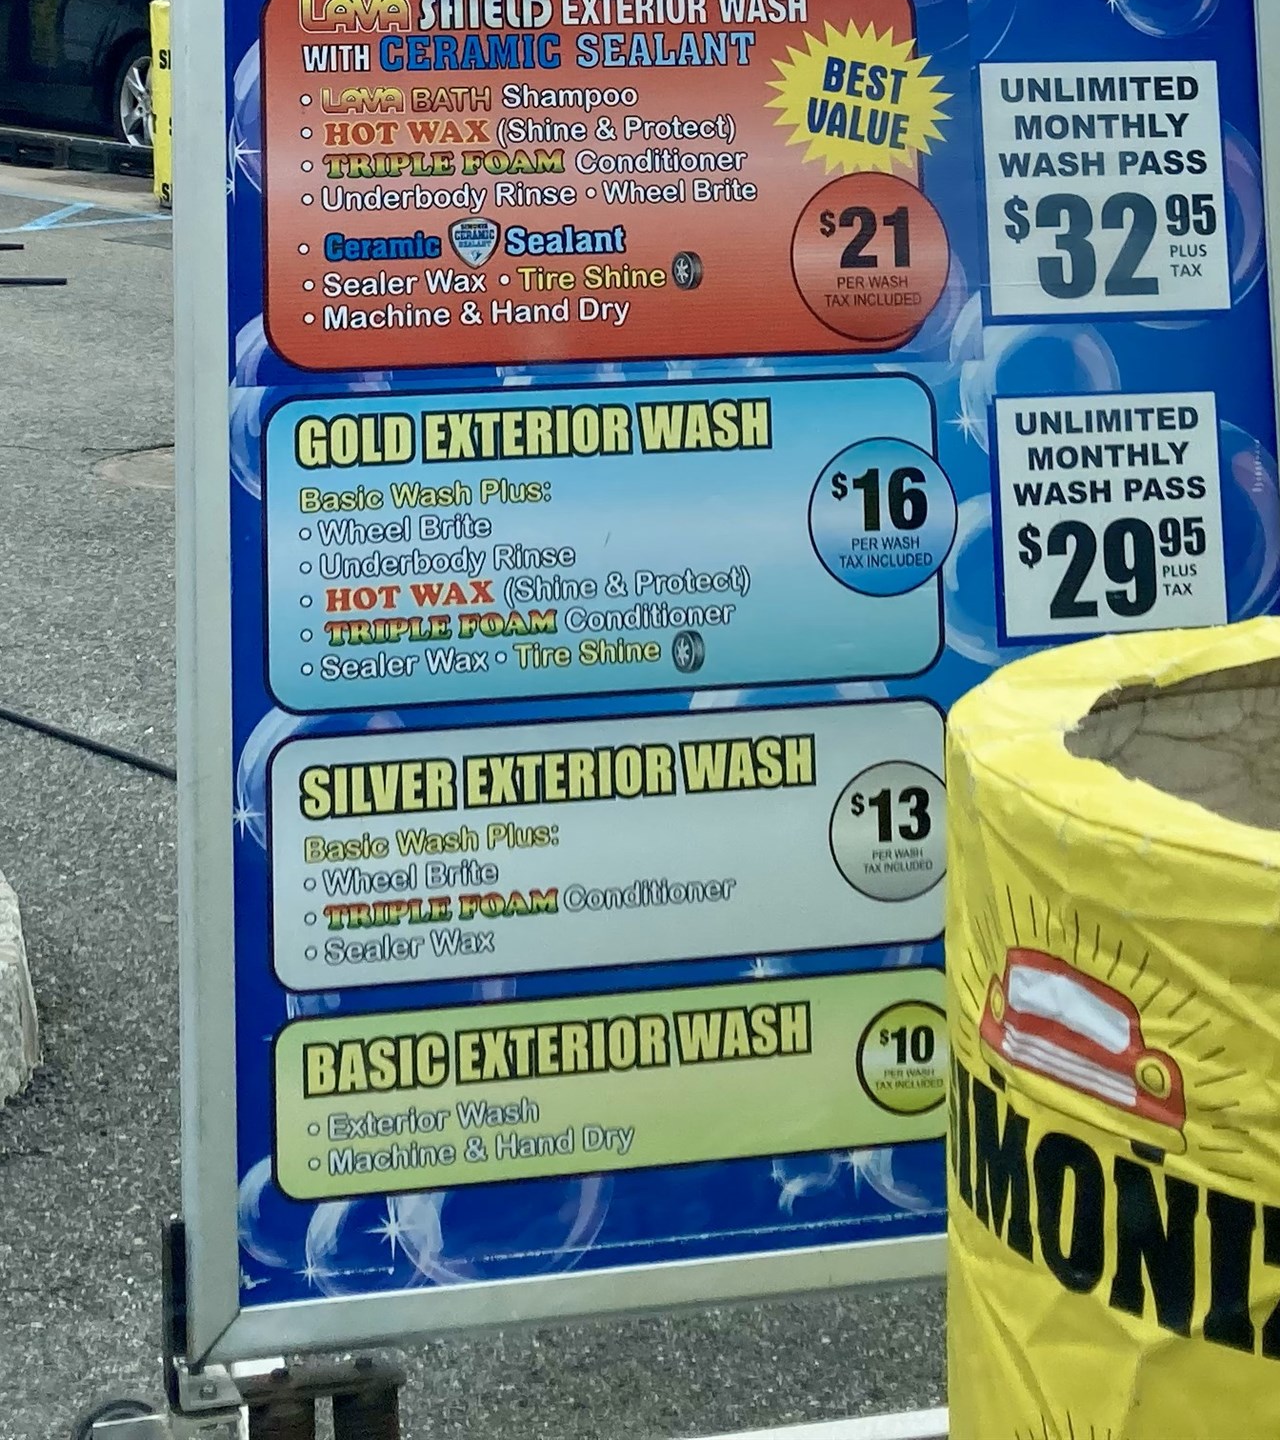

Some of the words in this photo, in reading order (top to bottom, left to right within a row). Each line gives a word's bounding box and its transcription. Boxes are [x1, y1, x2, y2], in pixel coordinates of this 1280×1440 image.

[302, 43, 371, 73] WITH
[379, 34, 561, 72] CERAMIC
[575, 31, 756, 67] SEALANT
[822, 56, 908, 106] BEST
[1000, 75, 1200, 103] UNLIMITED
[320, 86, 404, 114] LAVA
[410, 86, 492, 113] BATH
[500, 84, 639, 112] Shampoo
[323, 120, 399, 147] HOT
[407, 117, 491, 145] WAX
[496, 115, 587, 146] (Shine
[595, 116, 617, 140] &
[623, 114, 736, 143] Protect)
[806, 97, 911, 151] VALUE
[1014, 112, 1190, 140] MONTHLY
[322, 151, 454, 179] TRIPLE
[462, 149, 566, 175] FOAM
[575, 147, 747, 176] Conditioner
[998, 152, 1106, 178] WASH
[1118, 149, 1208, 176] PASS
[321, 182, 487, 215] Underbody
[494, 181, 576, 208] Rinse
[603, 179, 686, 205] Wheel
[691, 178, 758, 202] Brite
[323, 231, 442, 262] Ceramic
[504, 225, 627, 257] Sealant
[819, 205, 912, 270] $21
[1169, 243, 1208, 258] PLUS
[323, 272, 418, 298] Sealer
[425, 271, 487, 295] Wax
[517, 266, 576, 292] Tire
[584, 265, 667, 291] Shine
[836, 276, 865, 290] PER
[867, 275, 909, 289] WASH
[1169, 263, 1203, 278] TAX
[323, 304, 452, 332] Machine
[459, 303, 483, 327] &
[490, 300, 571, 324] Hand
[578, 298, 632, 327] Dry
[824, 293, 851, 309] TAX
[852, 292, 921, 308] INCLUDED
[296, 413, 417, 470] GOLD
[420, 404, 634, 465] EXTERIOR
[638, 397, 773, 454] WASH
[1014, 406, 1200, 436] UNLIMITED
[1027, 441, 1190, 471] MONTHLY
[299, 486, 385, 514] Basic
[391, 482, 472, 510] Wash
[480, 479, 552, 505] Plus:
[831, 466, 929, 532] $16
[1013, 479, 1112, 507] WASH
[1124, 475, 1207, 502] PASS
[318, 516, 412, 546] Wheel
[419, 514, 492, 541] Brite
[851, 537, 880, 551] PER
[881, 535, 921, 550] WASH
[319, 549, 487, 581] Underbody
[493, 544, 576, 571] Rinse
[839, 554, 865, 569] TAX
[866, 552, 934, 568] INCLUDED
[1162, 564, 1198, 578] PLUS
[325, 586, 402, 613] HOT
[410, 580, 495, 609] WAX
[503, 574, 598, 607] (Shine
[604, 573, 627, 598] &
[633, 565, 752, 597] Protect)
[1163, 583, 1193, 597] TAX
[325, 615, 453, 647] TRIPLE
[458, 608, 558, 641] FOAM
[564, 602, 737, 633] Conditioner
[320, 654, 419, 681] Sealer
[426, 649, 488, 675] Wax
[514, 643, 572, 669] Tire
[579, 637, 662, 665] Shine
[300, 759, 457, 820] SILVER
[464, 744, 677, 809] EXTERIOR
[679, 733, 817, 793] WASH
[850, 785, 932, 842] $13
[304, 835, 389, 863] Basic
[396, 826, 479, 856] Wash
[487, 822, 560, 849] Plus:
[872, 848, 892, 860] PER
[322, 864, 417, 896] Wheel
[424, 860, 500, 888] Brite
[863, 862, 882, 874] TAX
[323, 895, 453, 930] TRIPLE
[459, 888, 560, 922] FOAM
[563, 878, 738, 912] Conditioner
[323, 935, 426, 965] Sealer
[430, 928, 496, 955] Wax
[303, 1035, 450, 1098] BASIC
[455, 1016, 669, 1085] EXTERIOR
[674, 1000, 812, 1061] WASH
[879, 1024, 935, 1065] $10
[327, 1108, 451, 1140] Exterior
[457, 1098, 541, 1128] Wash
[328, 1141, 456, 1176] Machine
[463, 1137, 488, 1163] &
[495, 1130, 575, 1160] Hand
[582, 1124, 636, 1157] Dry
